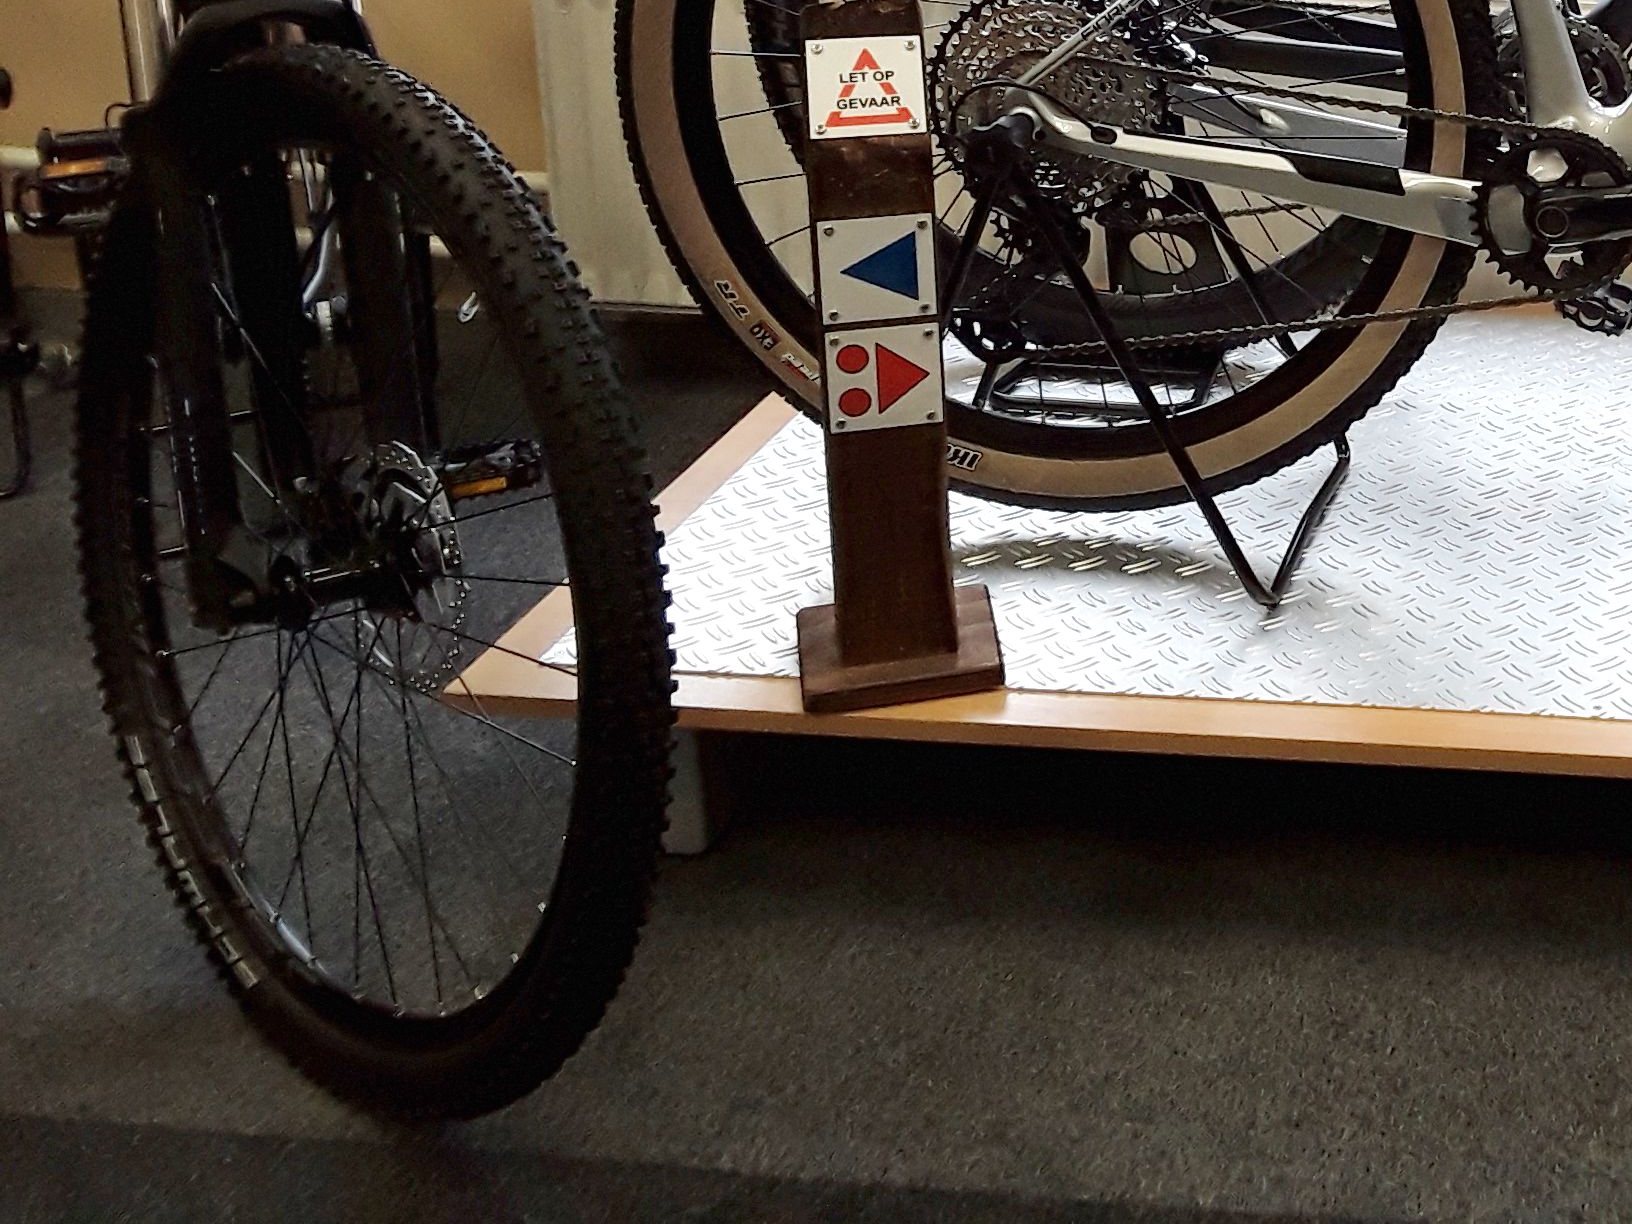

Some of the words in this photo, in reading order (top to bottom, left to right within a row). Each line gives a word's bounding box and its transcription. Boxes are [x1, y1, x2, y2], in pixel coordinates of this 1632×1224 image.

[839, 71, 868, 84] LET
[872, 70, 895, 82] OP
[836, 95, 902, 110] GEVAAR
[751, 321, 781, 351] EXO
[946, 442, 984, 472] IK
